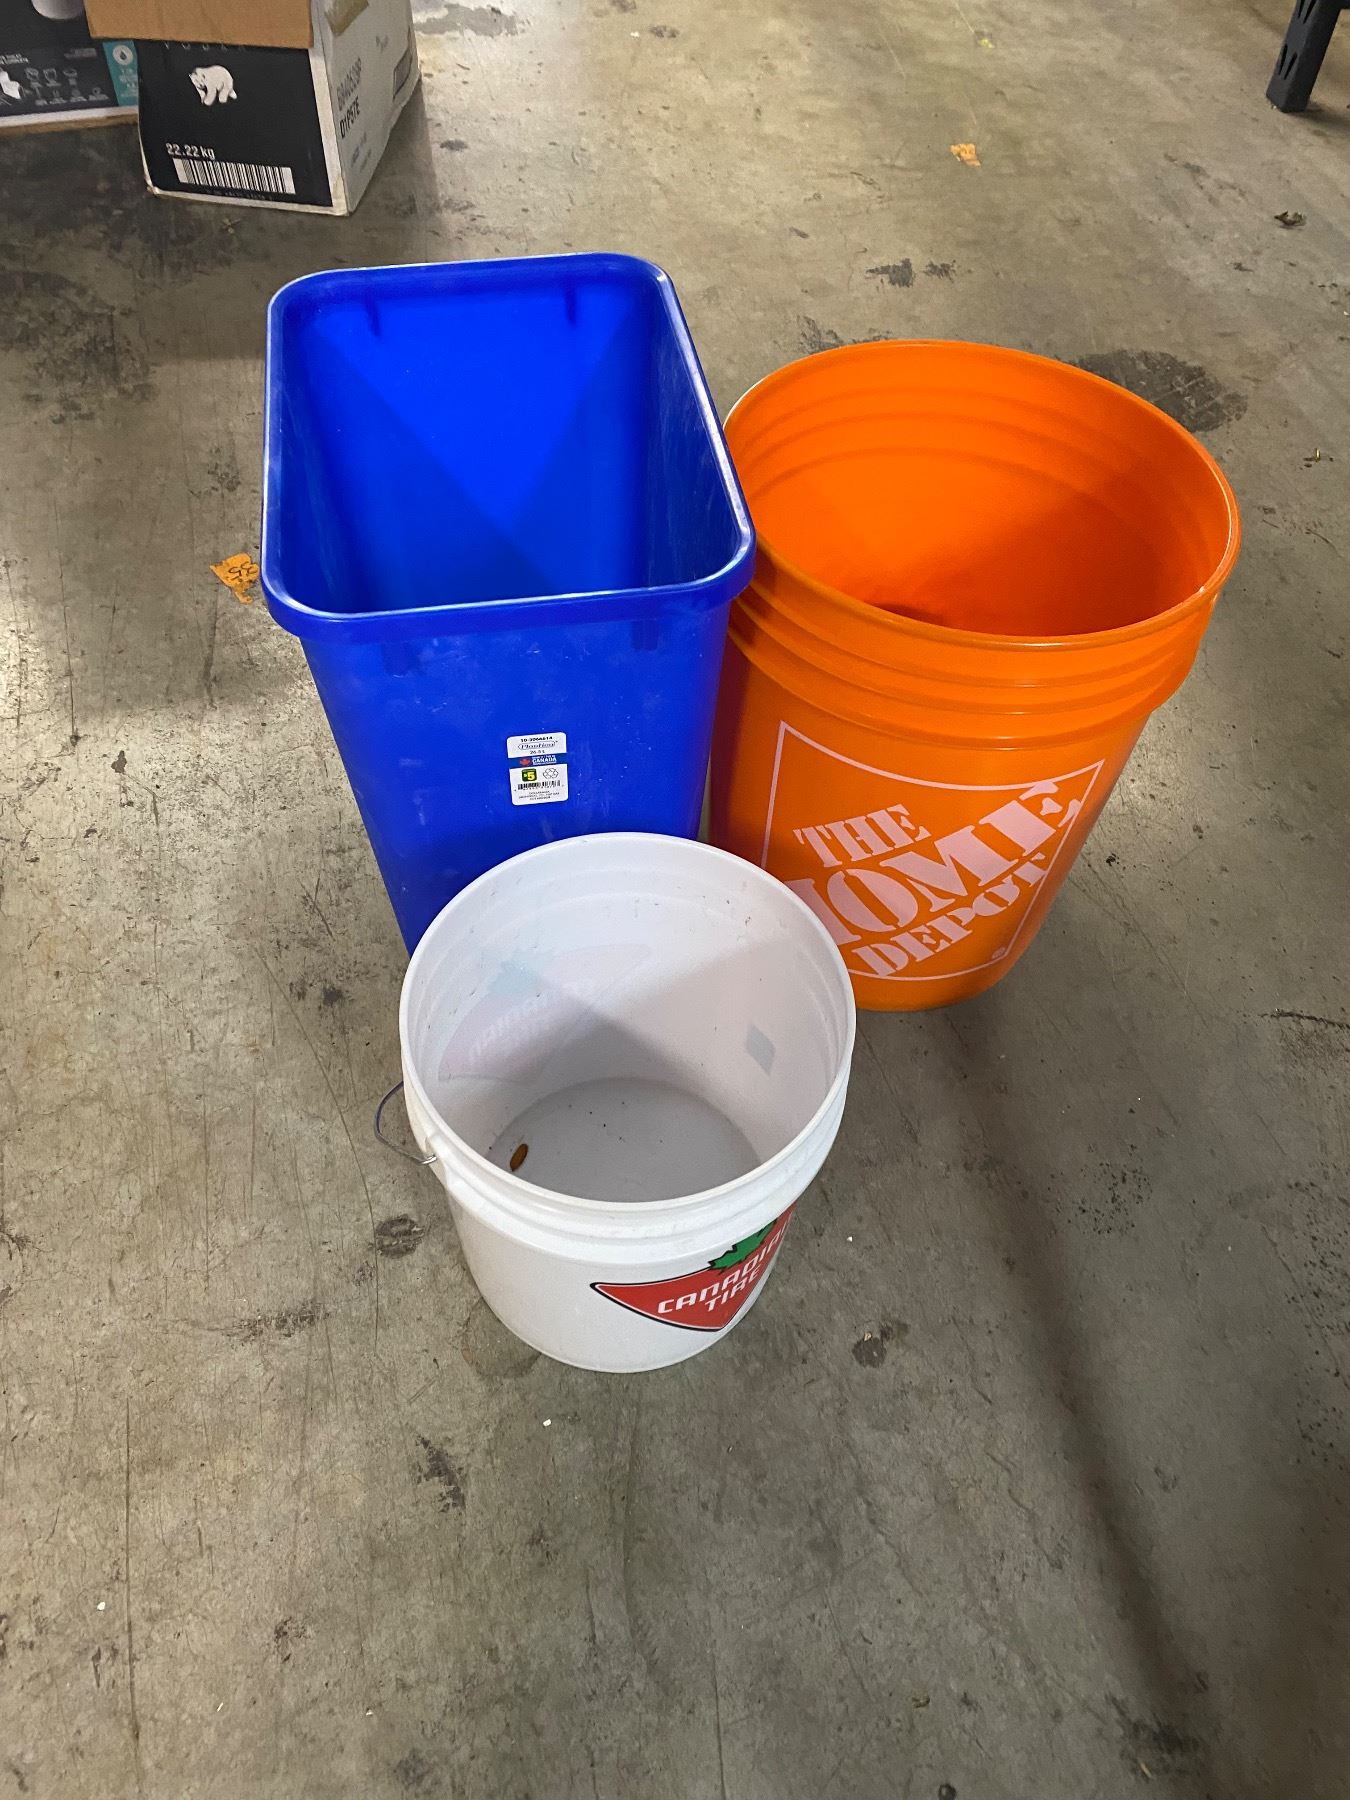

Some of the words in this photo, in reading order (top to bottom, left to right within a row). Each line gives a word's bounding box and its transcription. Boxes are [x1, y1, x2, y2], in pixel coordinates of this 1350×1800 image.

[165, 142, 200, 157] 22.22
[200, 146, 216, 160] kg
[792, 803, 932, 868] THE
[852, 851, 1049, 978] DEPOT
[705, 1264, 761, 1312] TIRE
